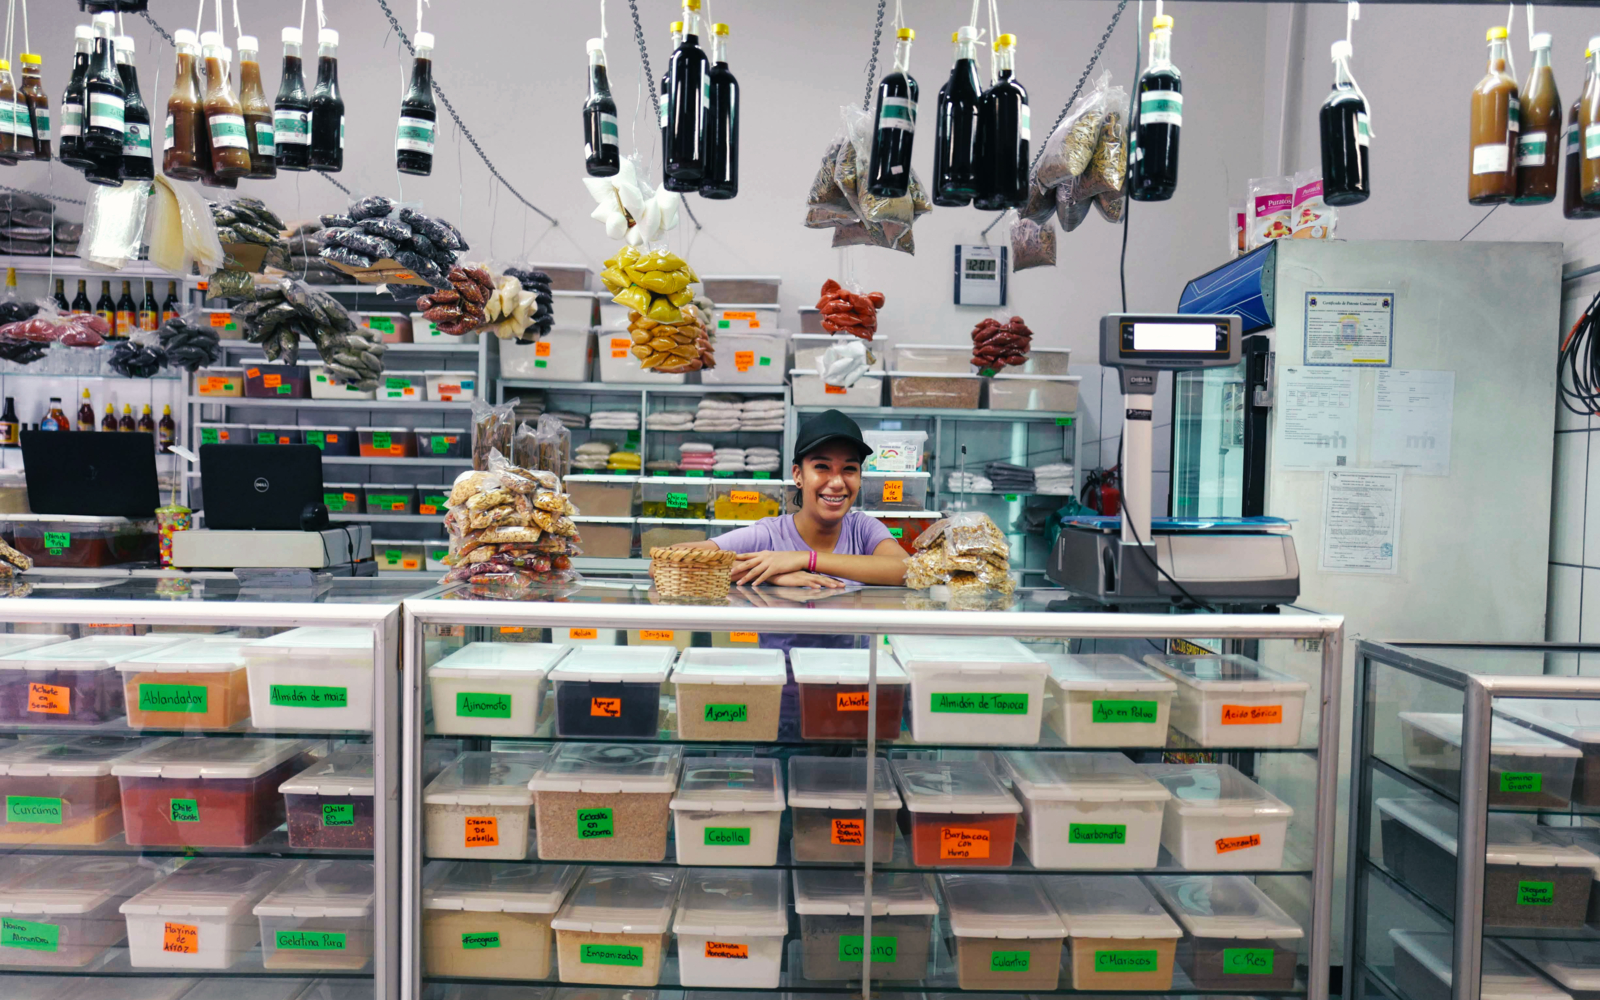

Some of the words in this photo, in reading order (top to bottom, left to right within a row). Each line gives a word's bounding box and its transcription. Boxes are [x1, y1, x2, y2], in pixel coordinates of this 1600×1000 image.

[142, 690, 203, 705] Ablandador
[272, 687, 307, 702] Almidón
[311, 689, 320, 702] de
[462, 697, 507, 712] Ajinomoto
[939, 696, 975, 710] Almidón
[978, 698, 989, 709] de
[990, 695, 1024, 711] Tapioca
[1097, 703, 1113, 720] Ajo
[1130, 706, 1153, 718] Polvo
[172, 803, 193, 812] Chile
[580, 813, 608, 821] Cebolla
[708, 830, 745, 842] Cebolla
[944, 829, 989, 841] Barbacoa
[1073, 827, 1123, 840] Bicarbonato
[948, 849, 969, 857] Humo
[165, 924, 197, 935] Harina
[176, 936, 186, 944] de
[279, 933, 320, 947] Gelatina
[322, 934, 343, 948] Pura
[587, 946, 639, 961] Empanizador
[992, 955, 1027, 967] Culantro
